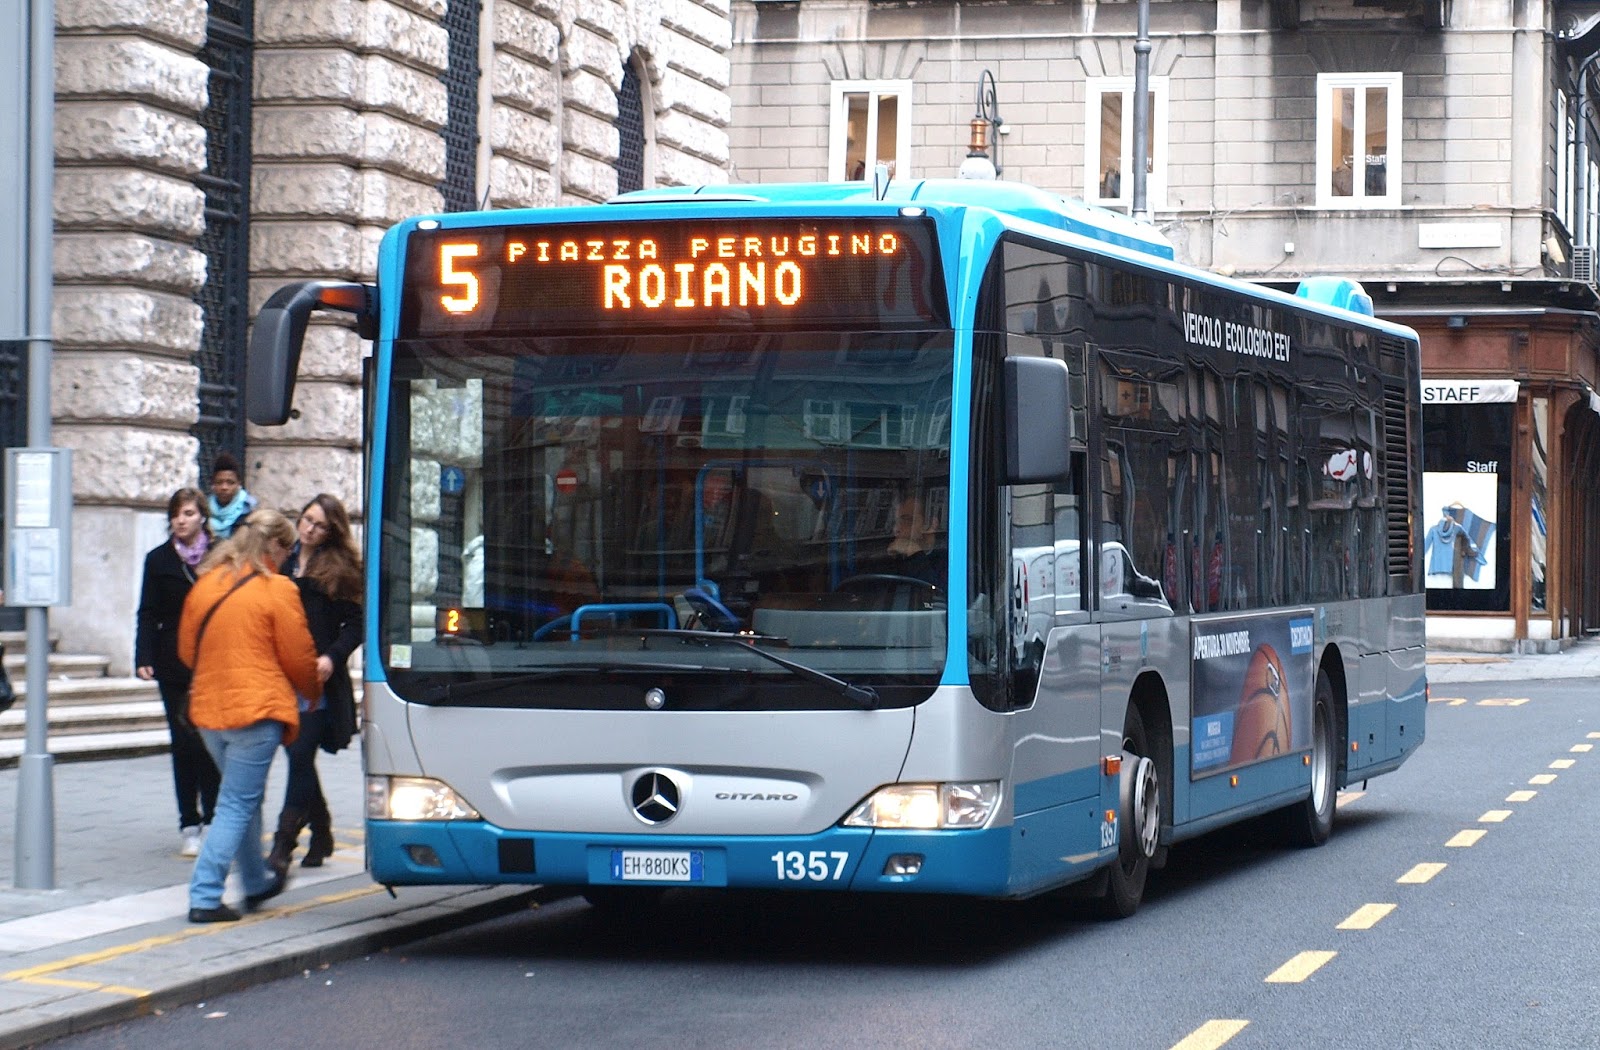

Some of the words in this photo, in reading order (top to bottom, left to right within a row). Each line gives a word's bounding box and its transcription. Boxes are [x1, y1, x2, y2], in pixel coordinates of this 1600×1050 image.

[508, 240, 657, 262] PIAZZA
[691, 234, 898, 258] PERUGINO
[440, 243, 479, 312] 5
[603, 262, 802, 309] ROIANO
[1182, 311, 1222, 348] VEICOLO
[1225, 321, 1273, 359] ECOLOGICO
[1274, 332, 1291, 362] EEV
[1423, 387, 1480, 401] STAFF
[1467, 460, 1498, 473] Staff
[447, 609, 459, 632] 2
[714, 793, 799, 801] CITARO
[771, 851, 849, 881] 1357
